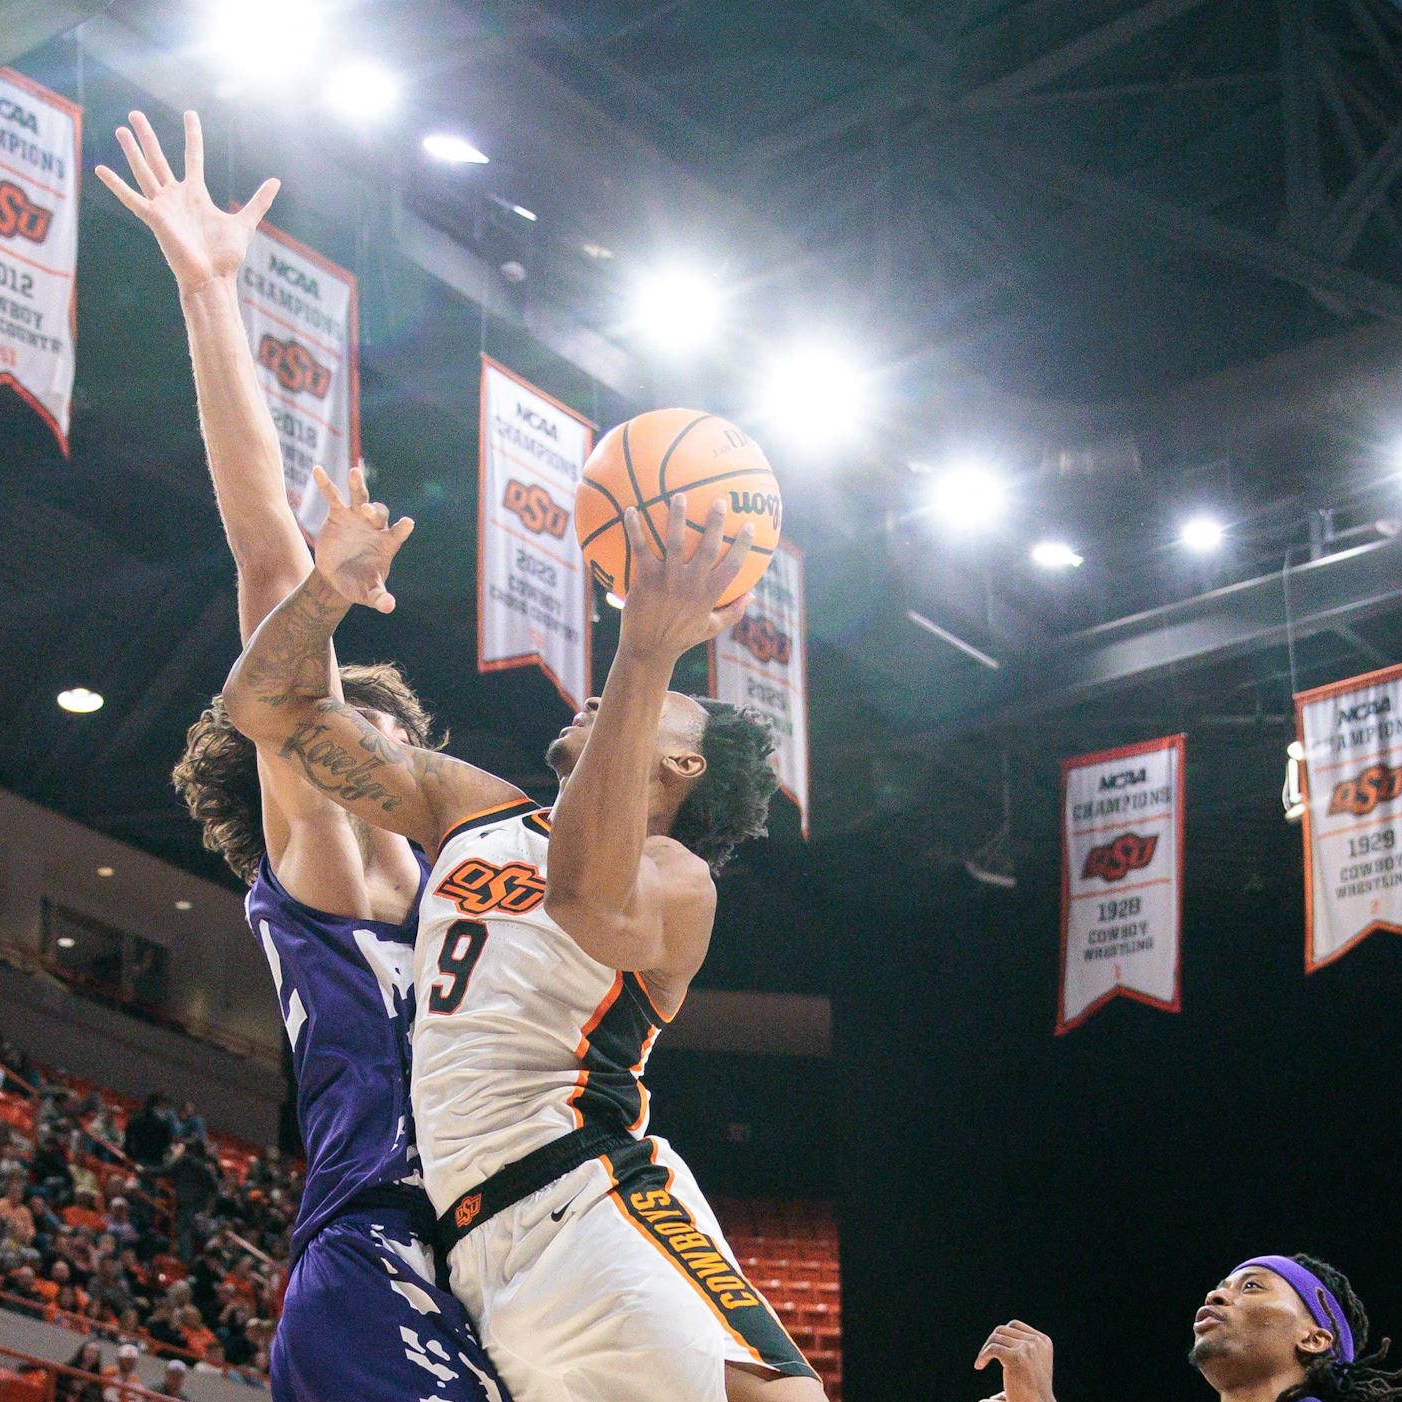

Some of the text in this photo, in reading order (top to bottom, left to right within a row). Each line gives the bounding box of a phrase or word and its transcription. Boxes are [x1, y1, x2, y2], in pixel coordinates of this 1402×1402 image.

[270, 254, 319, 300] NCAA
[258, 334, 332, 399] OSU
[517, 402, 557, 441] NCAA
[503, 478, 570, 539] OSU
[1338, 695, 1391, 727] NCAA
[1098, 767, 1147, 791] NCAA
[1072, 786, 1172, 823] CHAMPIONS
[1079, 832, 1160, 883] OSU
[1347, 828, 1396, 859] 1929
[434, 857, 549, 917] OSU
[1087, 920, 1149, 947] COWBOY
[427, 918, 489, 1016] 9
[630, 1189, 759, 1311] COWBOYS
